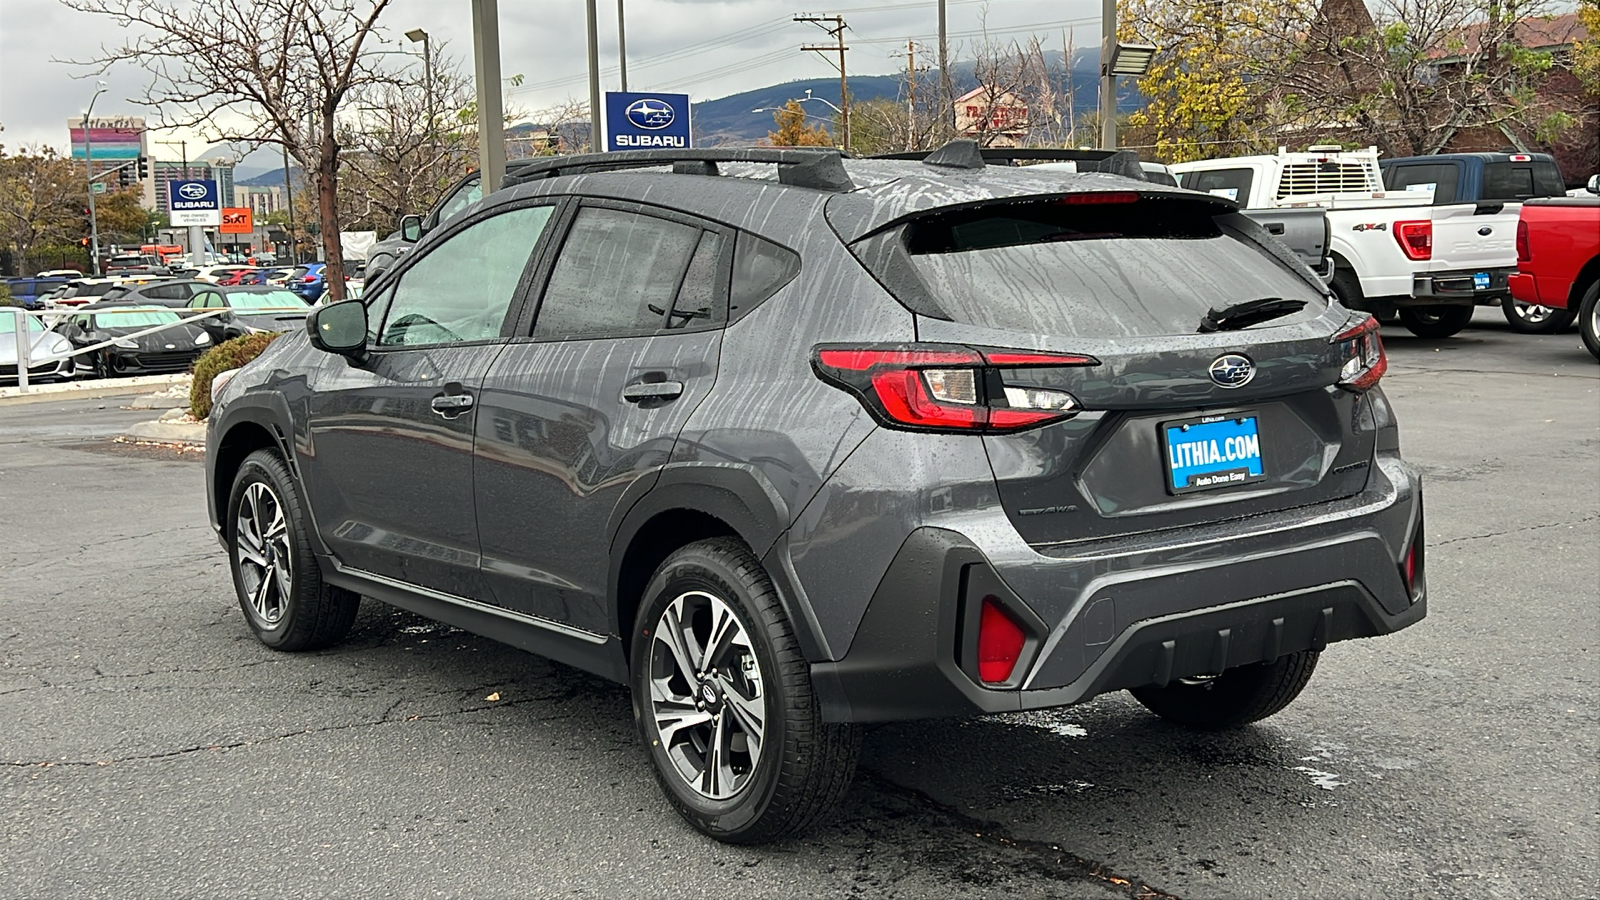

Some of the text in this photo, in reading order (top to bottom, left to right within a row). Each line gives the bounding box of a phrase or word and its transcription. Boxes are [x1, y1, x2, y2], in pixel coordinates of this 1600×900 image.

[616, 135, 685, 147] SUBARU
[174, 201, 215, 209] SUBARU
[1201, 416, 1225, 424] Lithia.com
[1169, 433, 1260, 469] LITHIA.COM
[1196, 472, 1246, 486] Auto Done Easy
